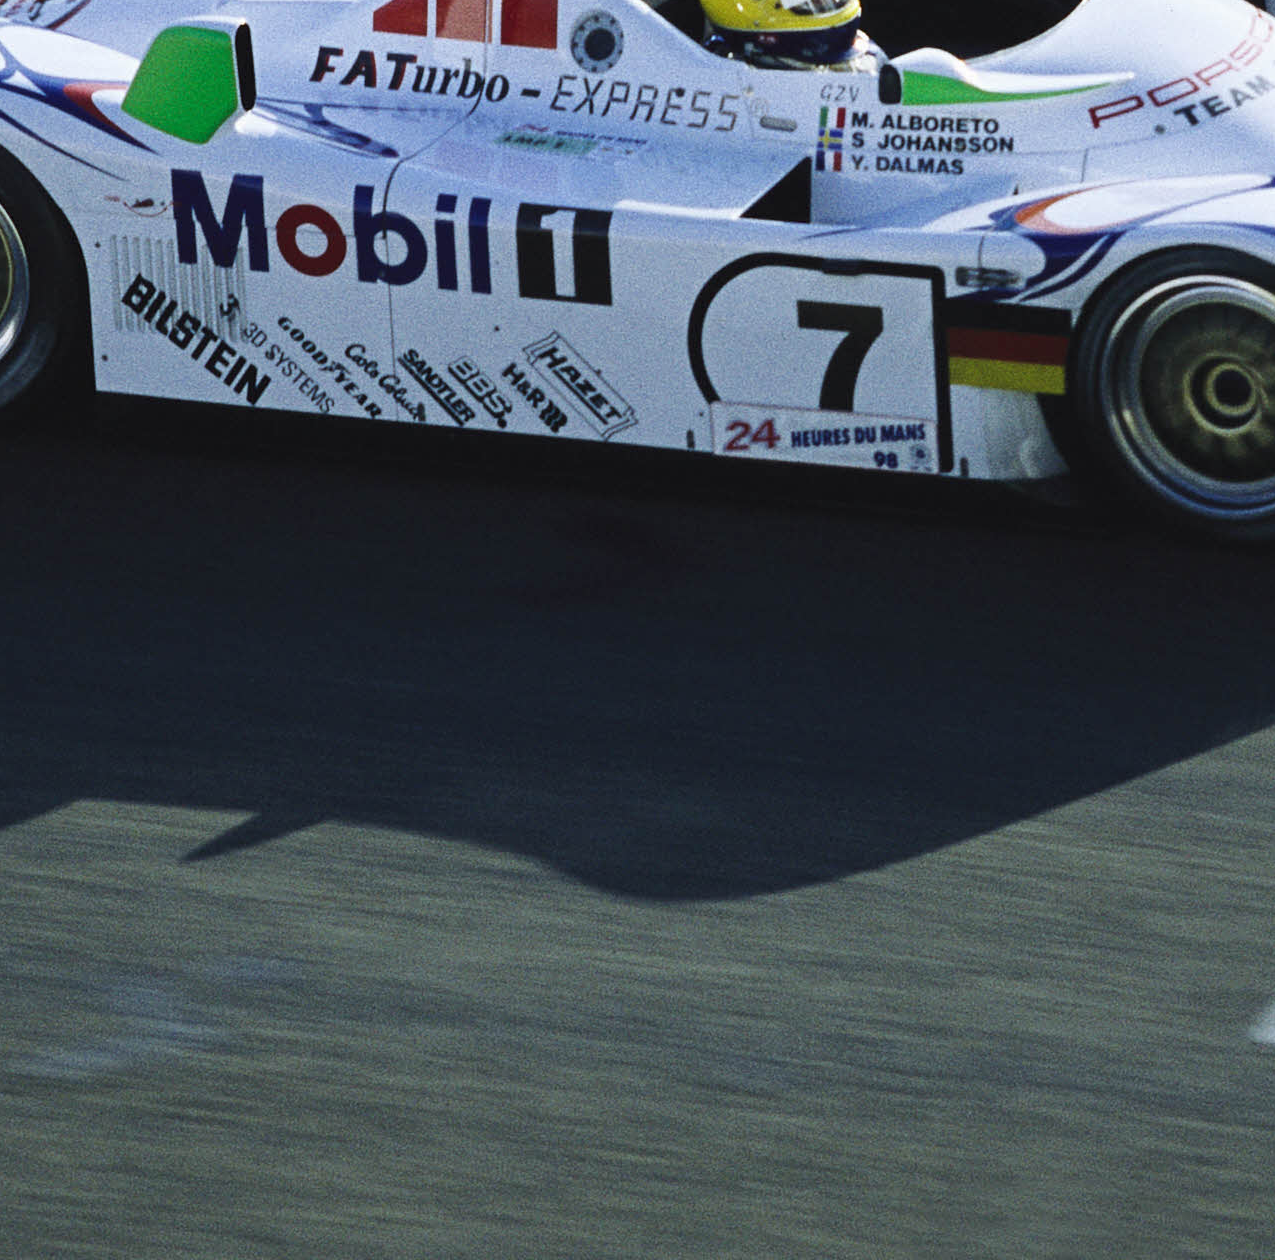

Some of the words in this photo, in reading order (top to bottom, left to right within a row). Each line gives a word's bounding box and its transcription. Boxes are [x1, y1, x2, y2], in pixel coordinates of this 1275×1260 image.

[550, 75, 740, 132] EXPRESS
[1088, 10, 1275, 130] PORSC
[851, 111, 875, 129] M.
[881, 113, 1000, 134] ALBORETO
[877, 134, 1014, 153] JOHANSSON
[851, 155, 869, 172] Y.
[875, 156, 965, 175] DALMAS
[170, 168, 492, 295] Mobil
[121, 272, 272, 406] BILSTEIN
[243, 322, 268, 347] 3D
[265, 344, 335, 413] SYSTEMS
[796, 299, 884, 413] 7
[401, 348, 476, 426] SANDTLER
[539, 345, 625, 424] HAZET
[724, 418, 781, 451] 24
[790, 426, 851, 448] HEURES
[853, 425, 876, 442] DU
[879, 423, 927, 442] MANS
[873, 451, 899, 469] 98
